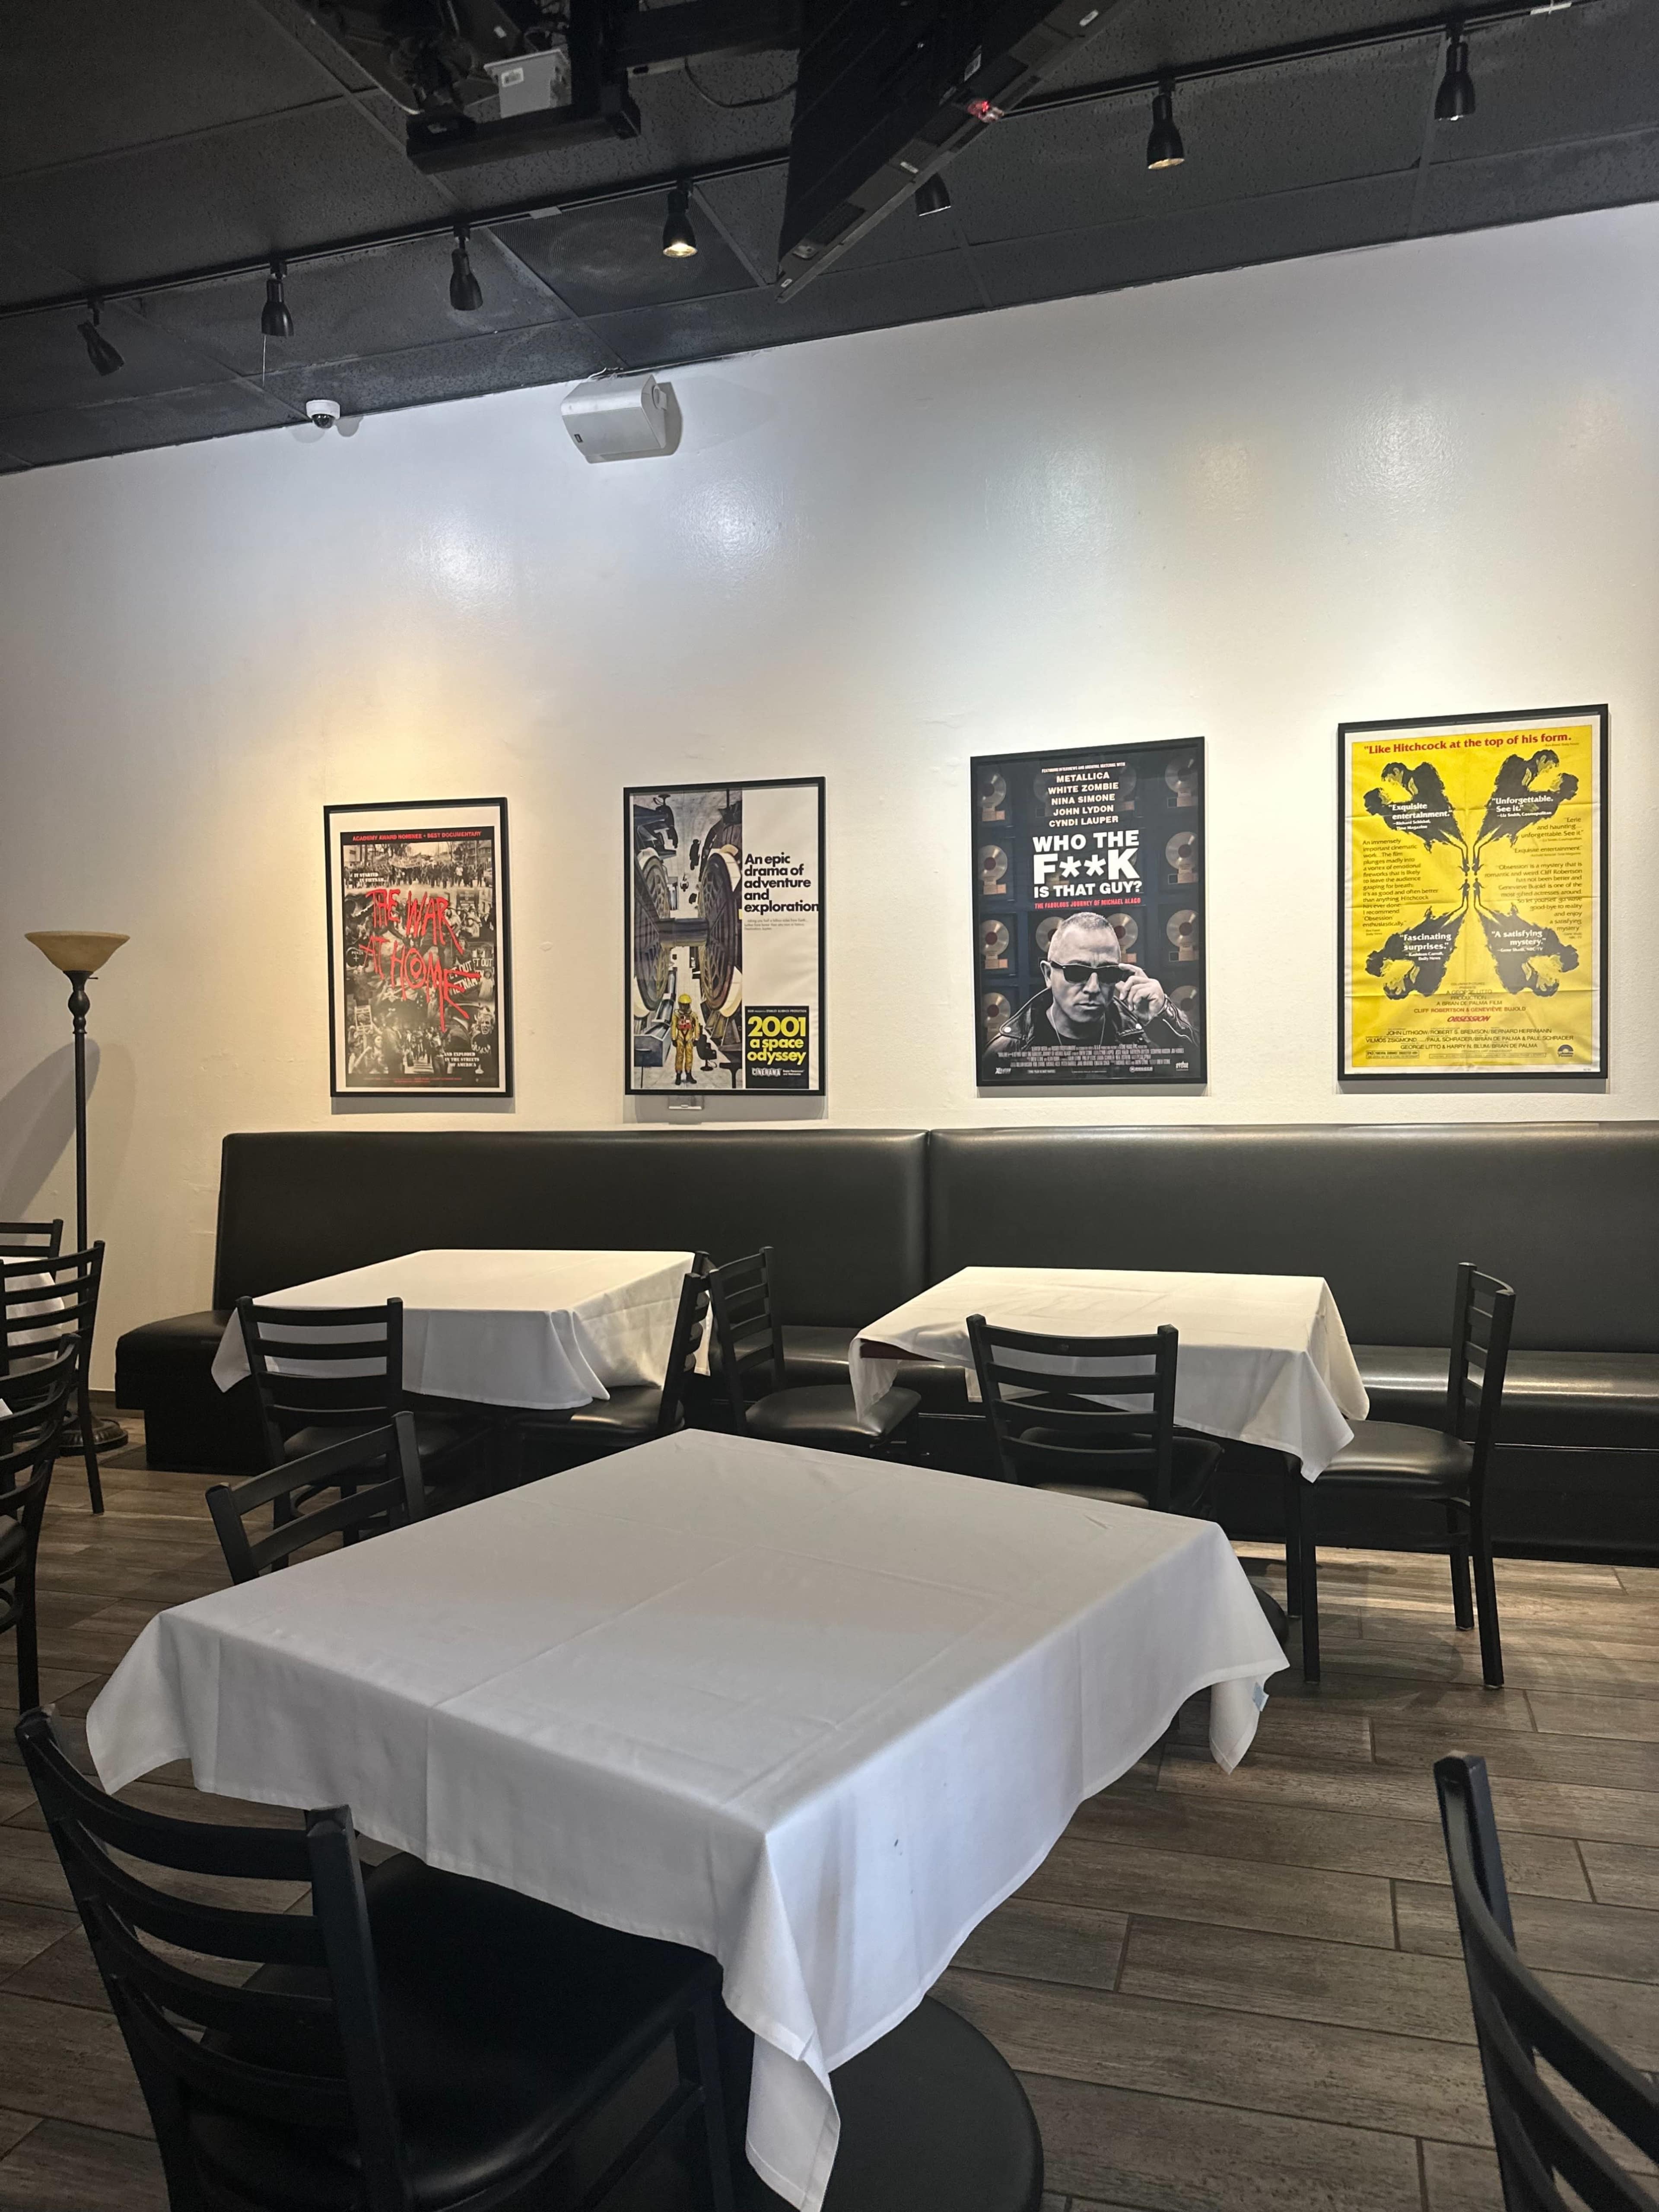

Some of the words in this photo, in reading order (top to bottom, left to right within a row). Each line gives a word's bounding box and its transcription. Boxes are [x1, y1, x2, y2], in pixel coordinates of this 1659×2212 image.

[1364, 745, 1391, 754] "Like
[1393, 741, 1446, 752] Hitchcock
[1484, 739, 1503, 747] top
[1507, 735, 1519, 744] of
[1522, 734, 1538, 743] his
[1541, 734, 1571, 742] form.
[1056, 772, 1109, 783] METALLICA
[1048, 785, 1078, 795] WHITE
[1081, 782, 1119, 792] ZOMBIE
[1051, 797, 1075, 805] NINA
[1078, 794, 1115, 803] SIMONE
[1492, 796, 1553, 804] "Unforgettable.
[1053, 807, 1080, 816] JOHN
[1082, 805, 1114, 814] LYDON
[1389, 803, 1427, 812] "Exquisite
[1392, 810, 1453, 820] entertainment."
[1049, 818, 1078, 827] CYNDI
[1081, 816, 1119, 825] LAUPER
[1033, 834, 1086, 852] WHO
[1093, 830, 1139, 848] THE
[745, 854, 763, 864] An
[765, 852, 790, 867] epic
[744, 864, 788, 876] drama
[790, 863, 804, 875] of
[744, 877, 811, 888] adventure
[744, 889, 769, 900] and
[1034, 886, 1049, 898] IS
[1053, 884, 1095, 897] THAT
[1100, 880, 1142, 894] GUY?
[744, 900, 819, 915] exploration
[365, 889, 400, 928] THE
[406, 890, 464, 955] WAR
[1399, 933, 1452, 941] "Fascinating
[1510, 938, 1546, 946] mystery."
[1404, 942, 1449, 951] surprises."
[359, 935, 391, 979] AT
[390, 940, 481, 1033] HOME
[748, 1016, 806, 1037] 2001
[750, 1039, 760, 1048] a
[762, 1039, 804, 1051] space
[747, 1048, 806, 1065] odyssey
[752, 1067, 781, 1076] CINERAMA
